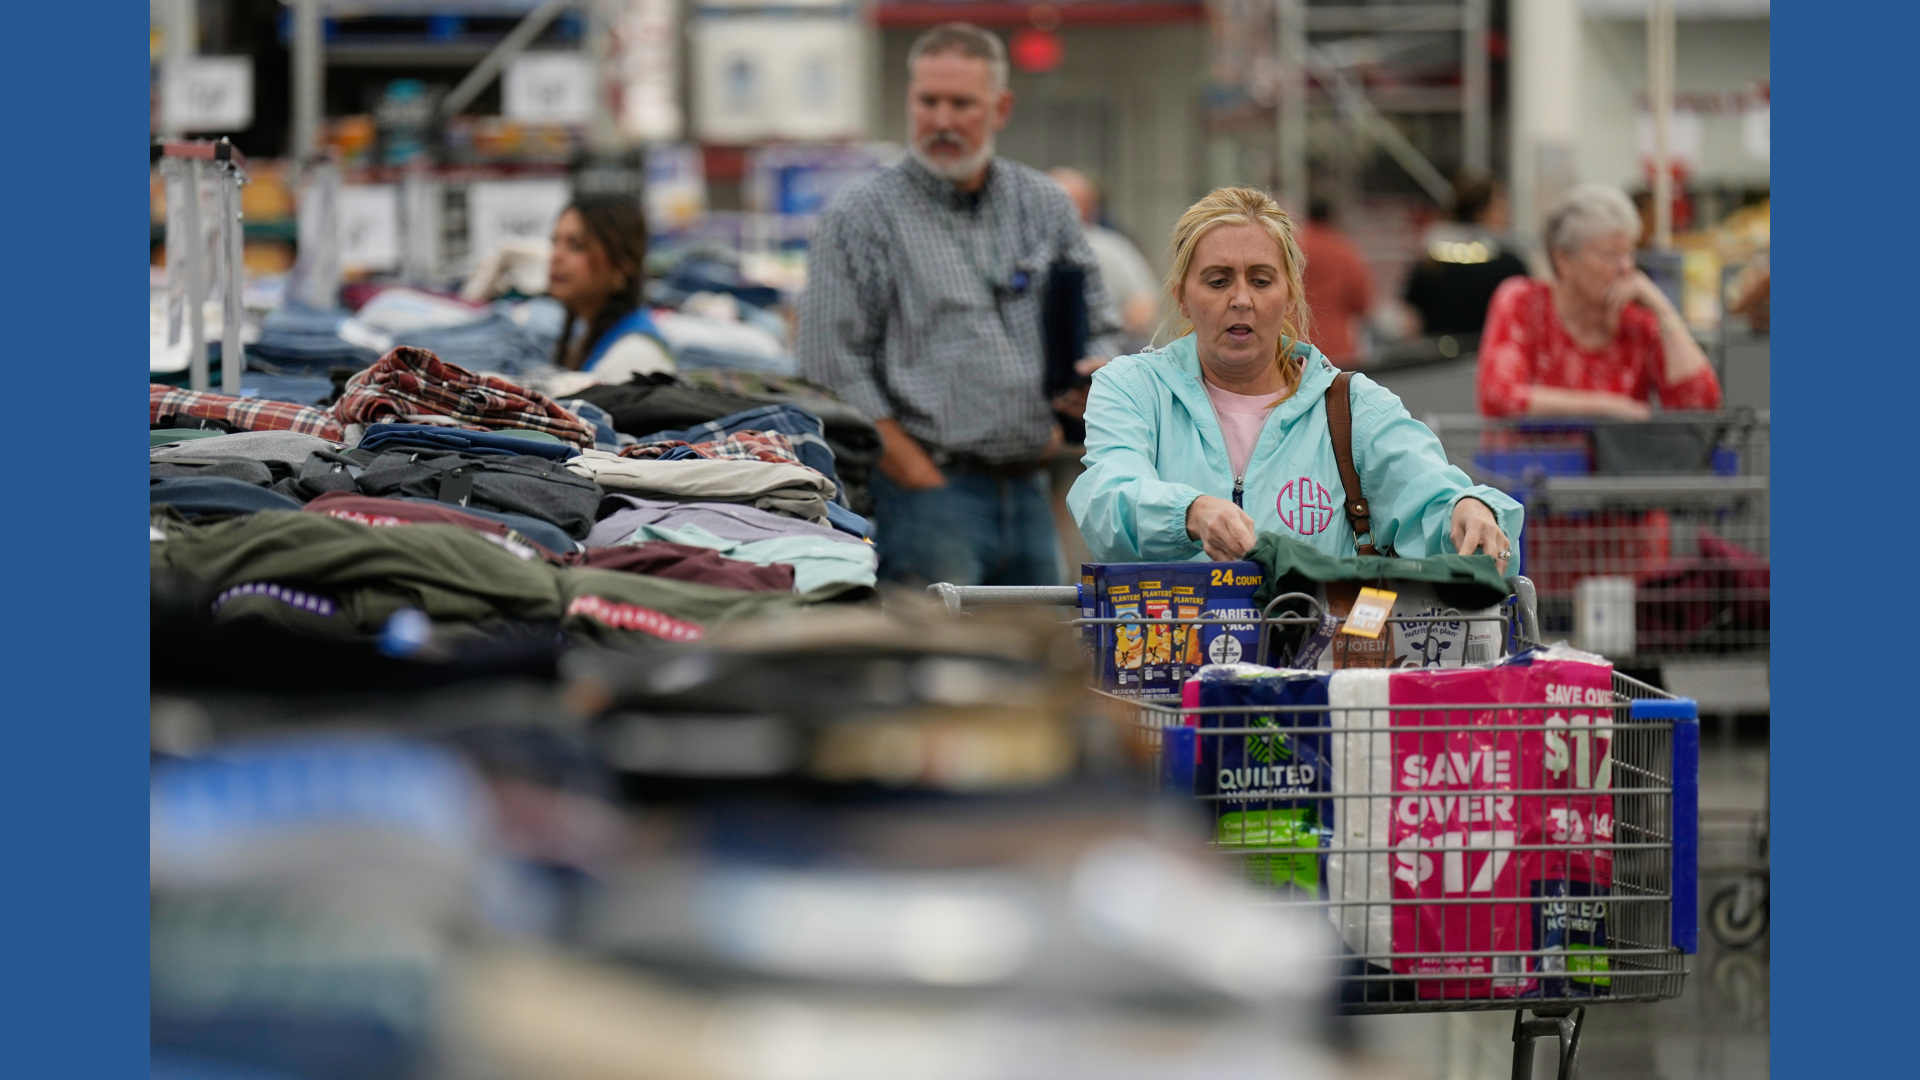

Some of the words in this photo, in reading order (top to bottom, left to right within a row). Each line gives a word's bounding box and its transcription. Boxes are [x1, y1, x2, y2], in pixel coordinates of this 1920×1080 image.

[1211, 568, 1234, 586] 24
[1236, 575, 1263, 586] COUNT
[1111, 593, 1141, 603] PLANTERS
[1142, 590, 1173, 598] PLANTERS
[1173, 596, 1204, 605] PLANTERS
[1211, 608, 1262, 620] VARIETY
[1440, 628, 1456, 638] plan
[1545, 683, 1582, 704] SAVE
[1545, 712, 1613, 789] $17
[1219, 764, 1315, 790] QUILTED
[1402, 750, 1511, 787] SAVE
[1398, 792, 1514, 825] OVER
[1394, 830, 1515, 893] $17
